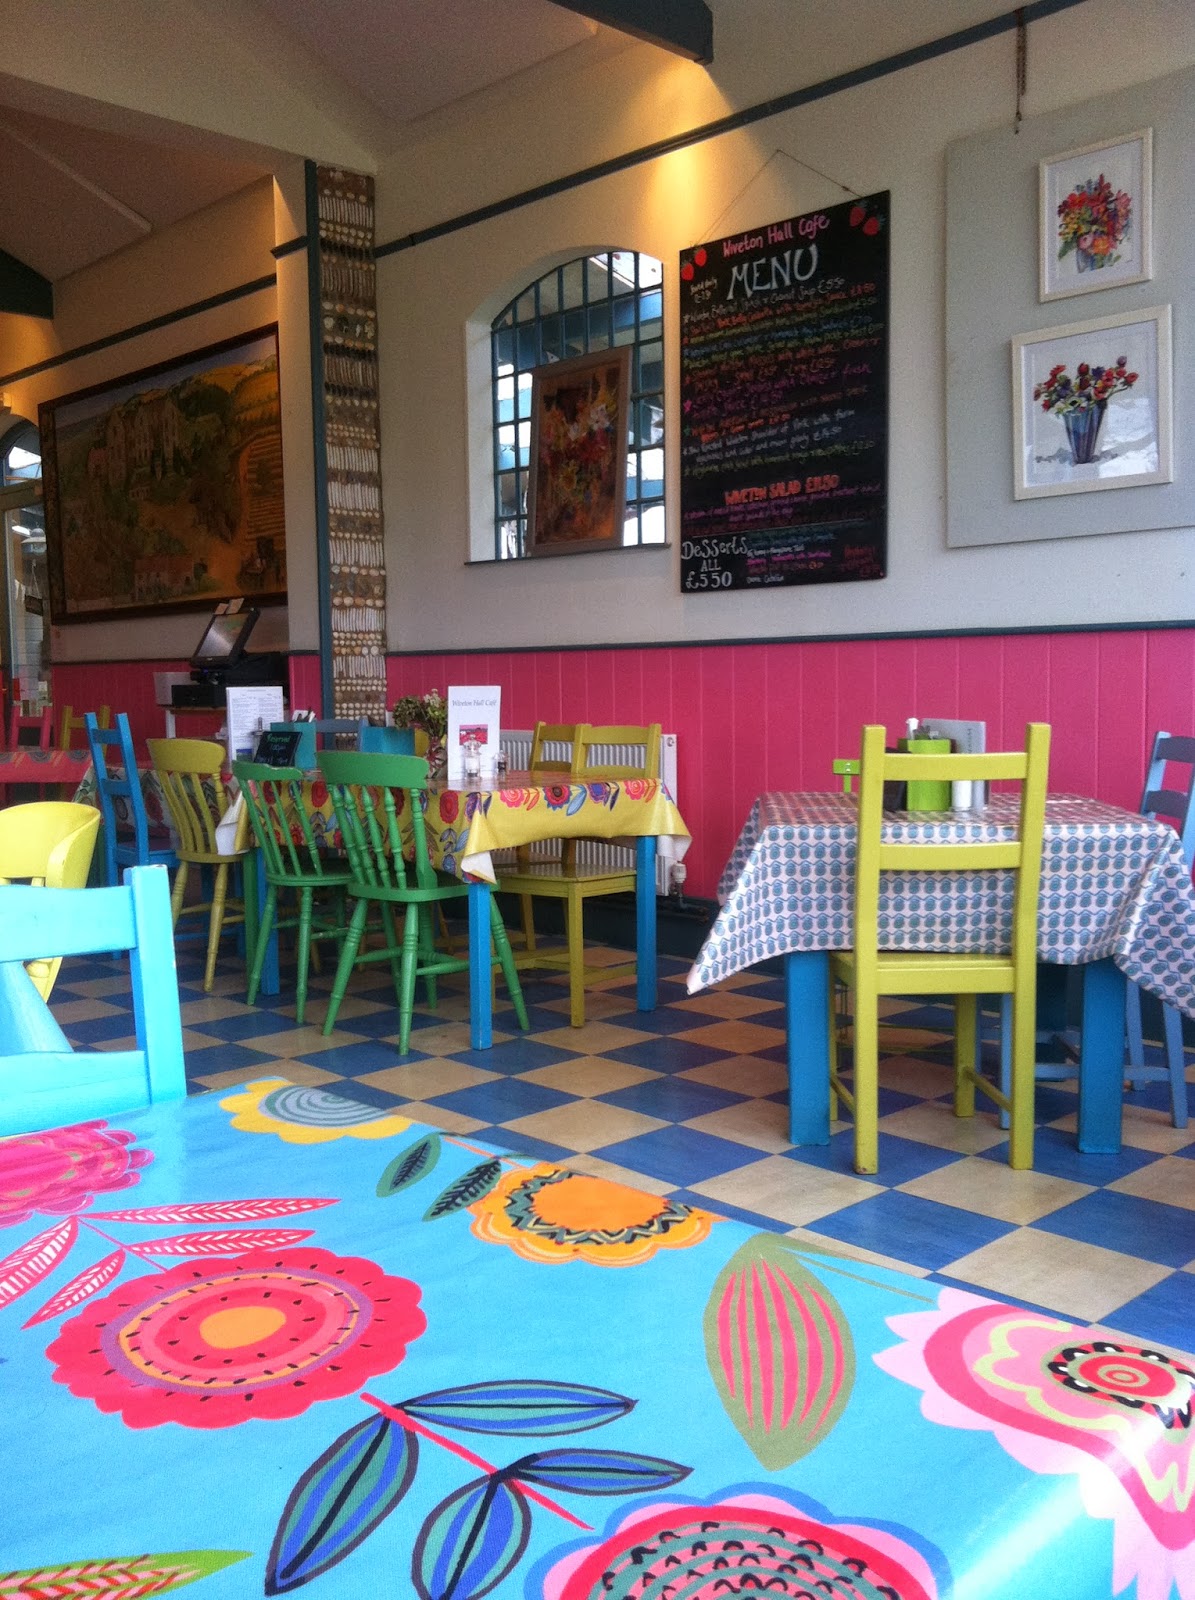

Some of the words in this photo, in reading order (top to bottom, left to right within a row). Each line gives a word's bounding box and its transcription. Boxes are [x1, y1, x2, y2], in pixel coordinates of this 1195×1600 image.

[723, 235, 763, 258] Wiveton
[767, 222, 793, 244] Hall
[726, 243, 819, 300] MENU
[769, 480, 801, 499] SALAD
[700, 559, 721, 573] ALL
